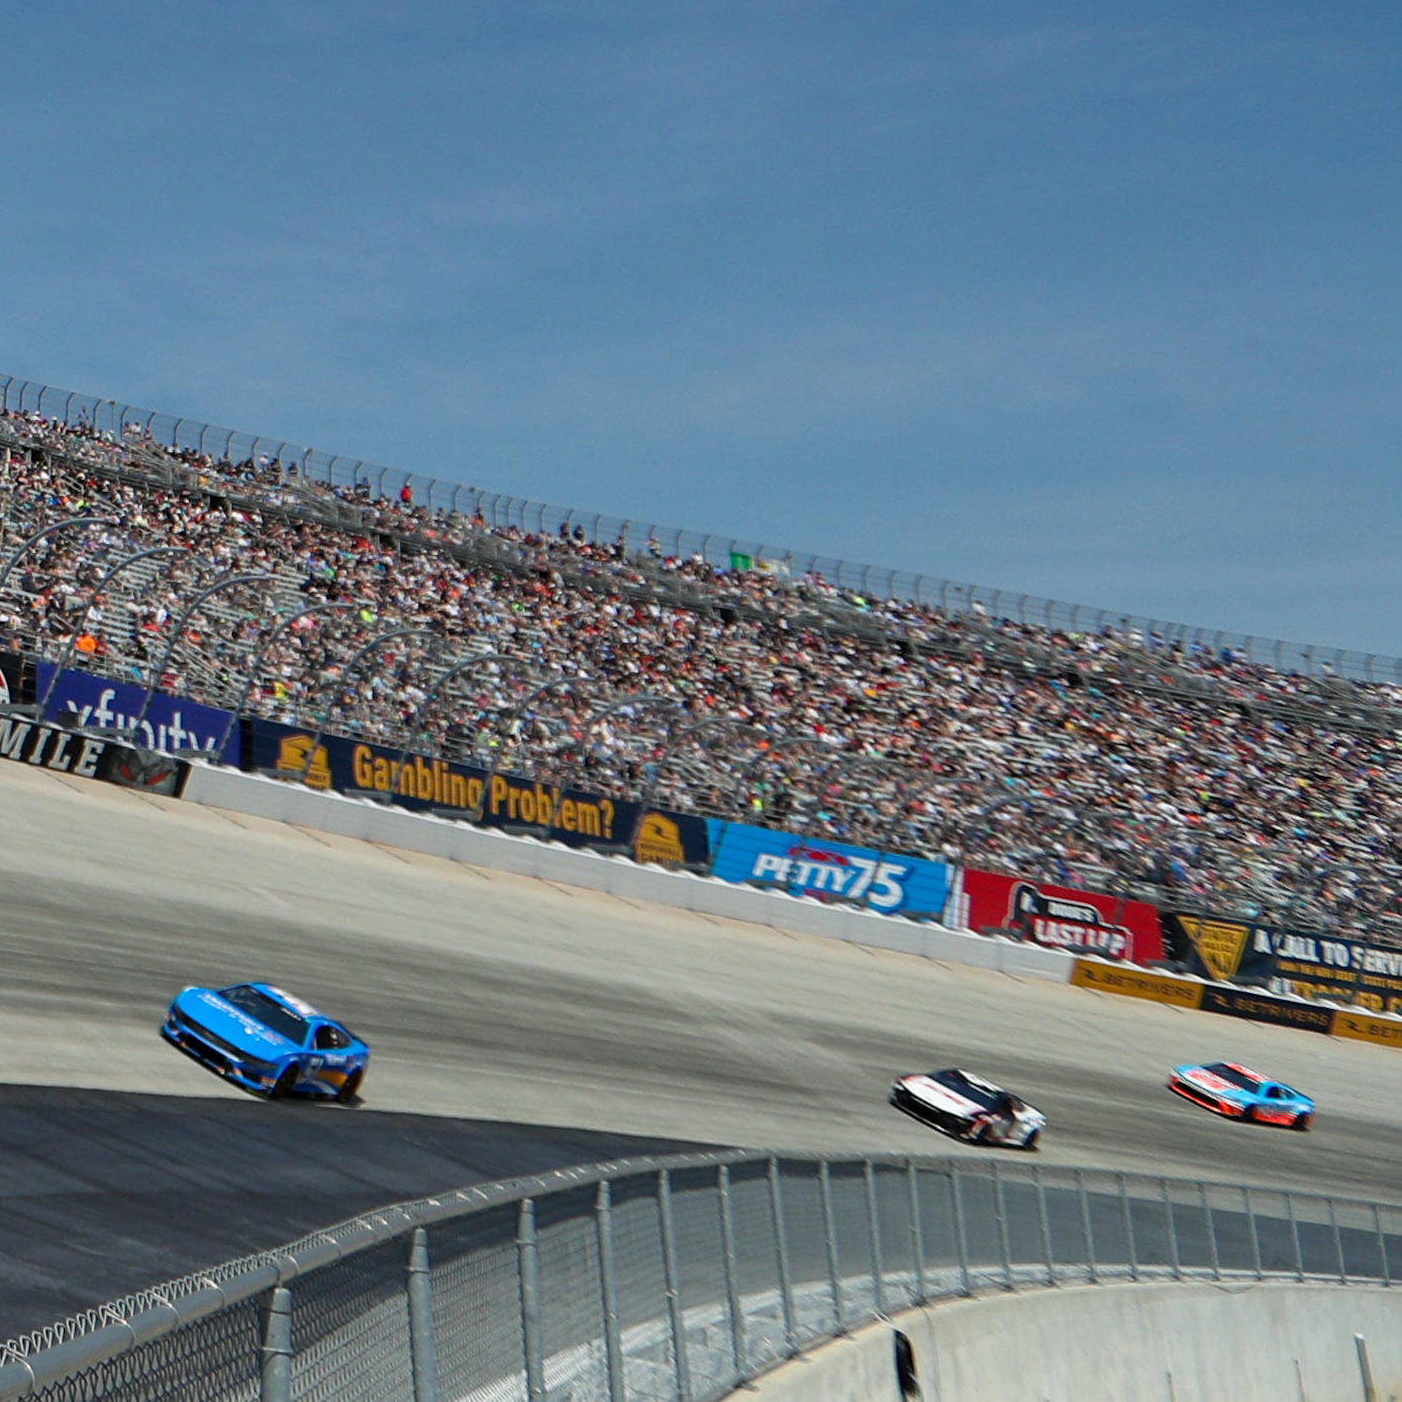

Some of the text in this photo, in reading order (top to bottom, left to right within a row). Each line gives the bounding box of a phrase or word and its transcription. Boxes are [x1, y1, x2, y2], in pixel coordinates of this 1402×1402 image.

[351, 743, 616, 840] Gambling Problem?
[752, 853, 907, 908] PETTY 75
